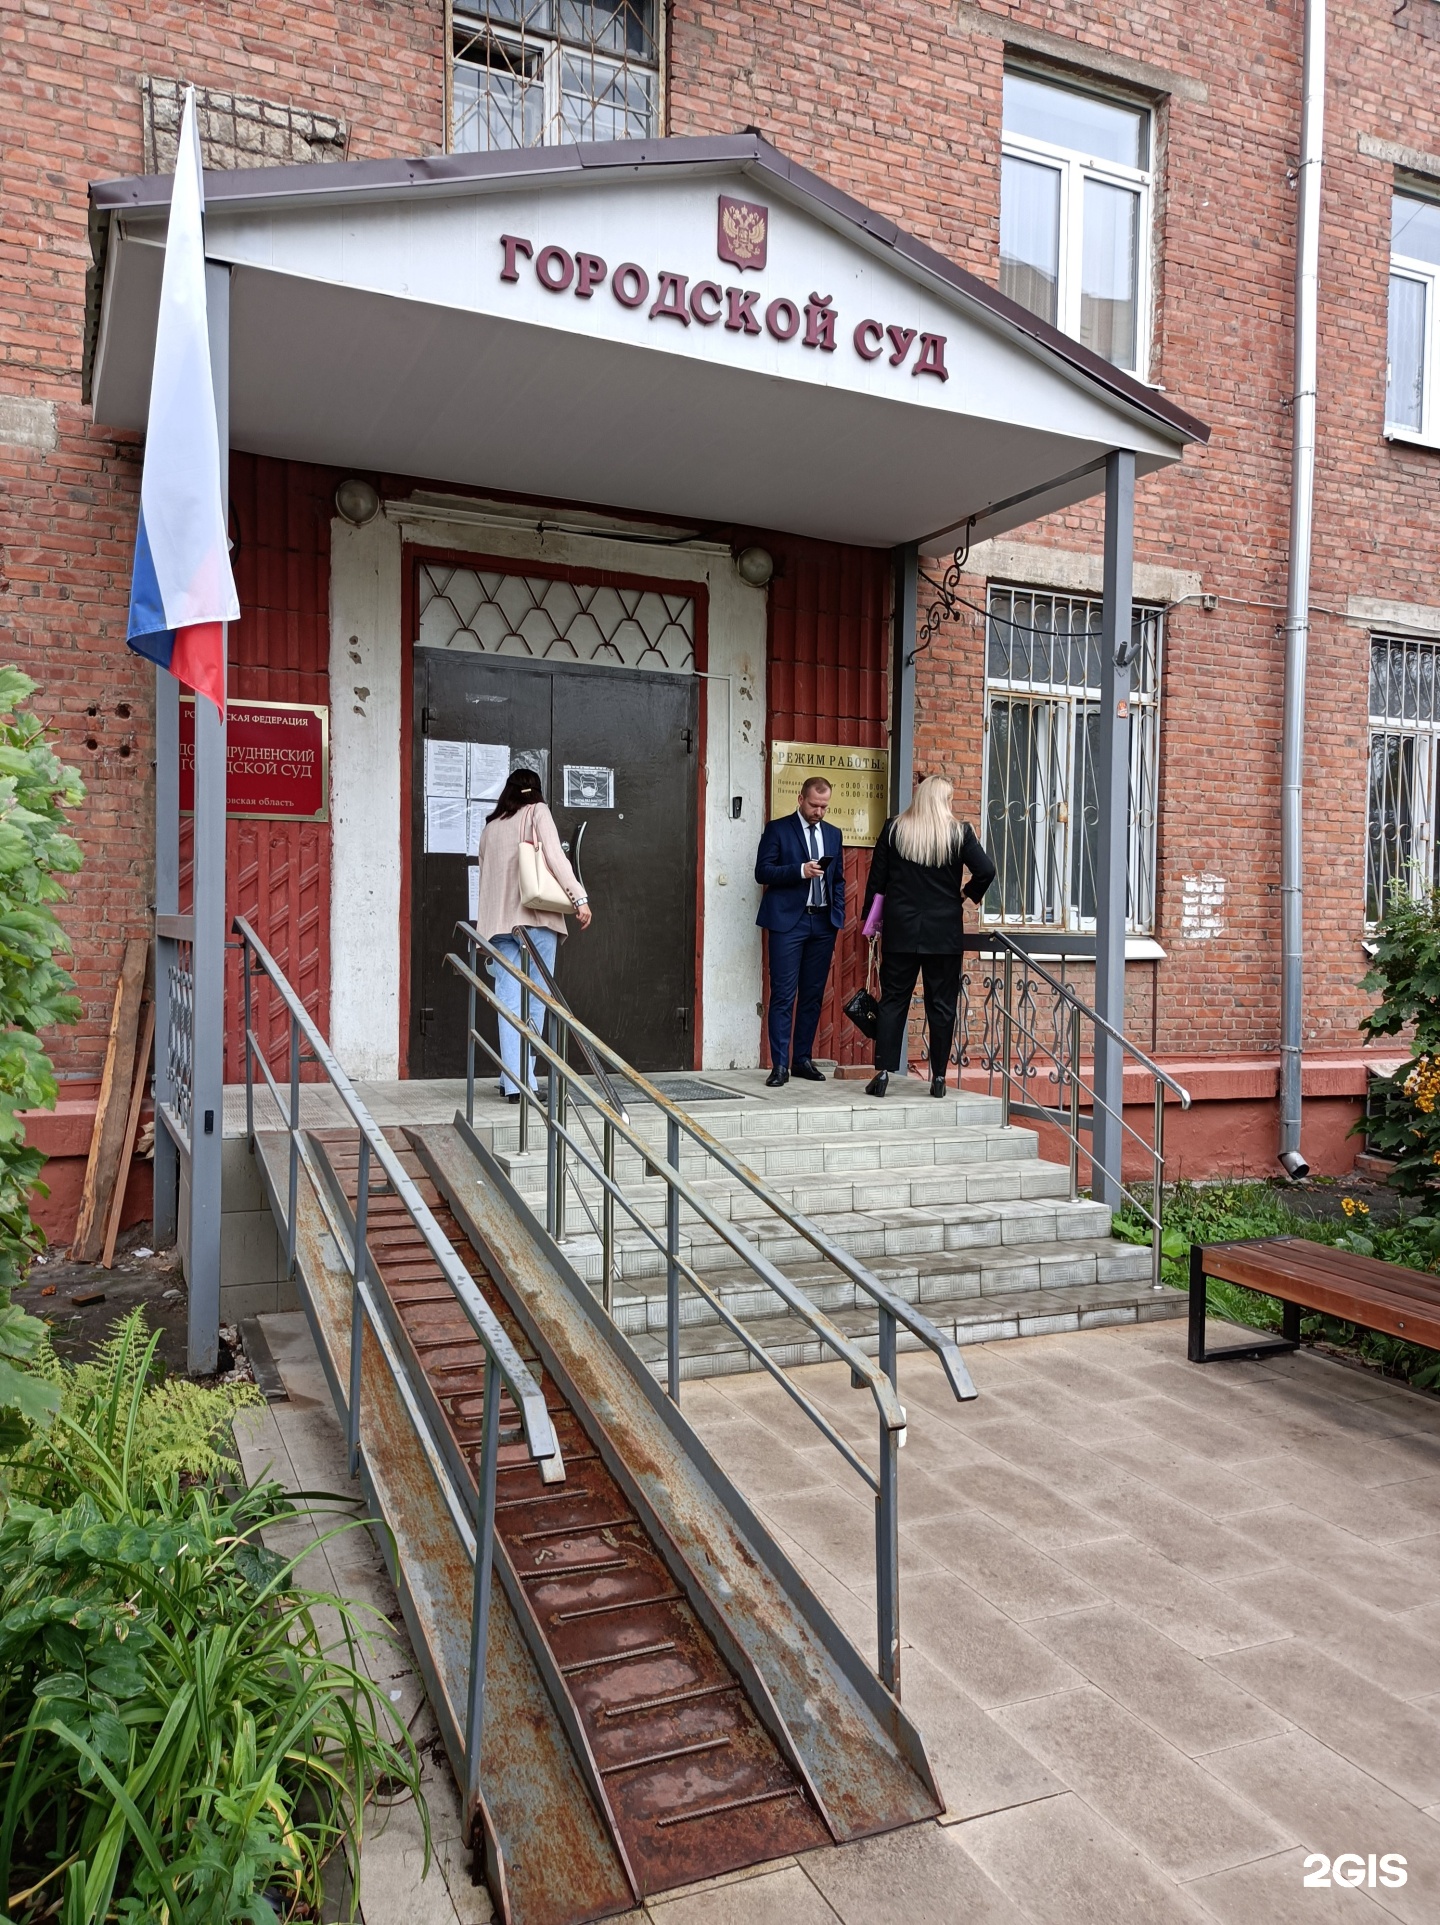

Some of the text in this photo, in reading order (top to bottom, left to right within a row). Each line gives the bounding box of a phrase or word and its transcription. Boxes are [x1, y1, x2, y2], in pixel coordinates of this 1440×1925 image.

[500, 234, 949, 382] ГОРОДСКОЙ СУД
[184, 710, 309, 727] РОСКАЯ ФЕДЕРАЦИЯ
[778, 751, 885, 770] РЕЖИМ РАБОТЫ:
[280, 763, 312, 779] СУД
[258, 797, 295, 807] область
